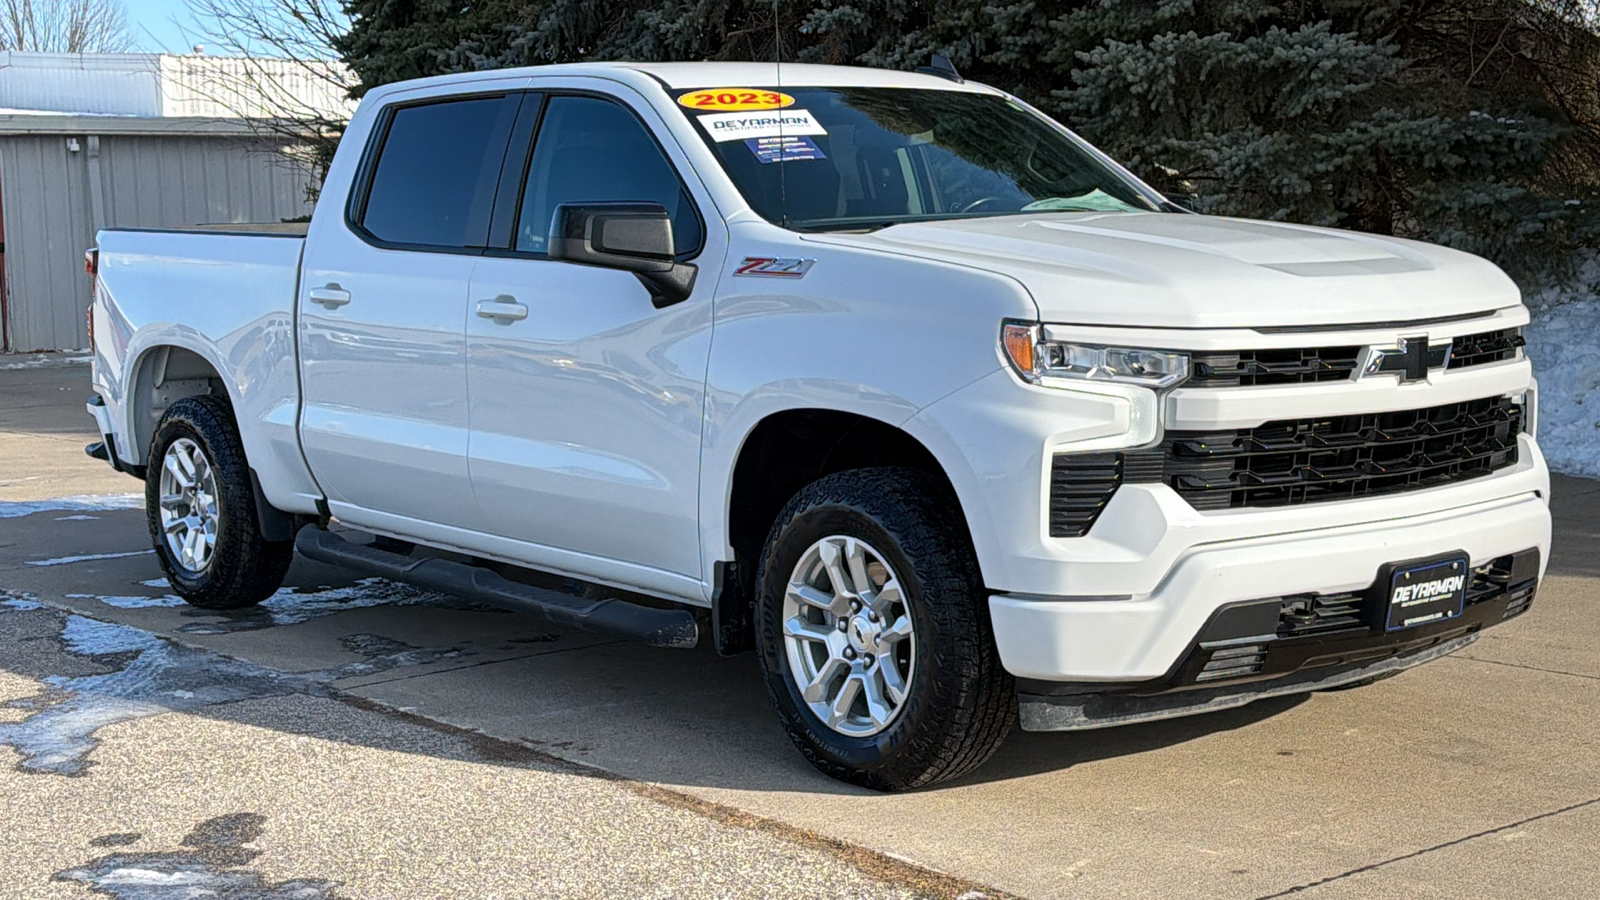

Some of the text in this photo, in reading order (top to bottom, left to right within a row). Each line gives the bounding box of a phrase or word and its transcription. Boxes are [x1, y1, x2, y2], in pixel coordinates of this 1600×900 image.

[694, 93, 782, 107] 2023
[713, 117, 809, 129] DEYARMAN
[733, 256, 817, 279] Z71
[1391, 574, 1465, 604] DEYARMAN
